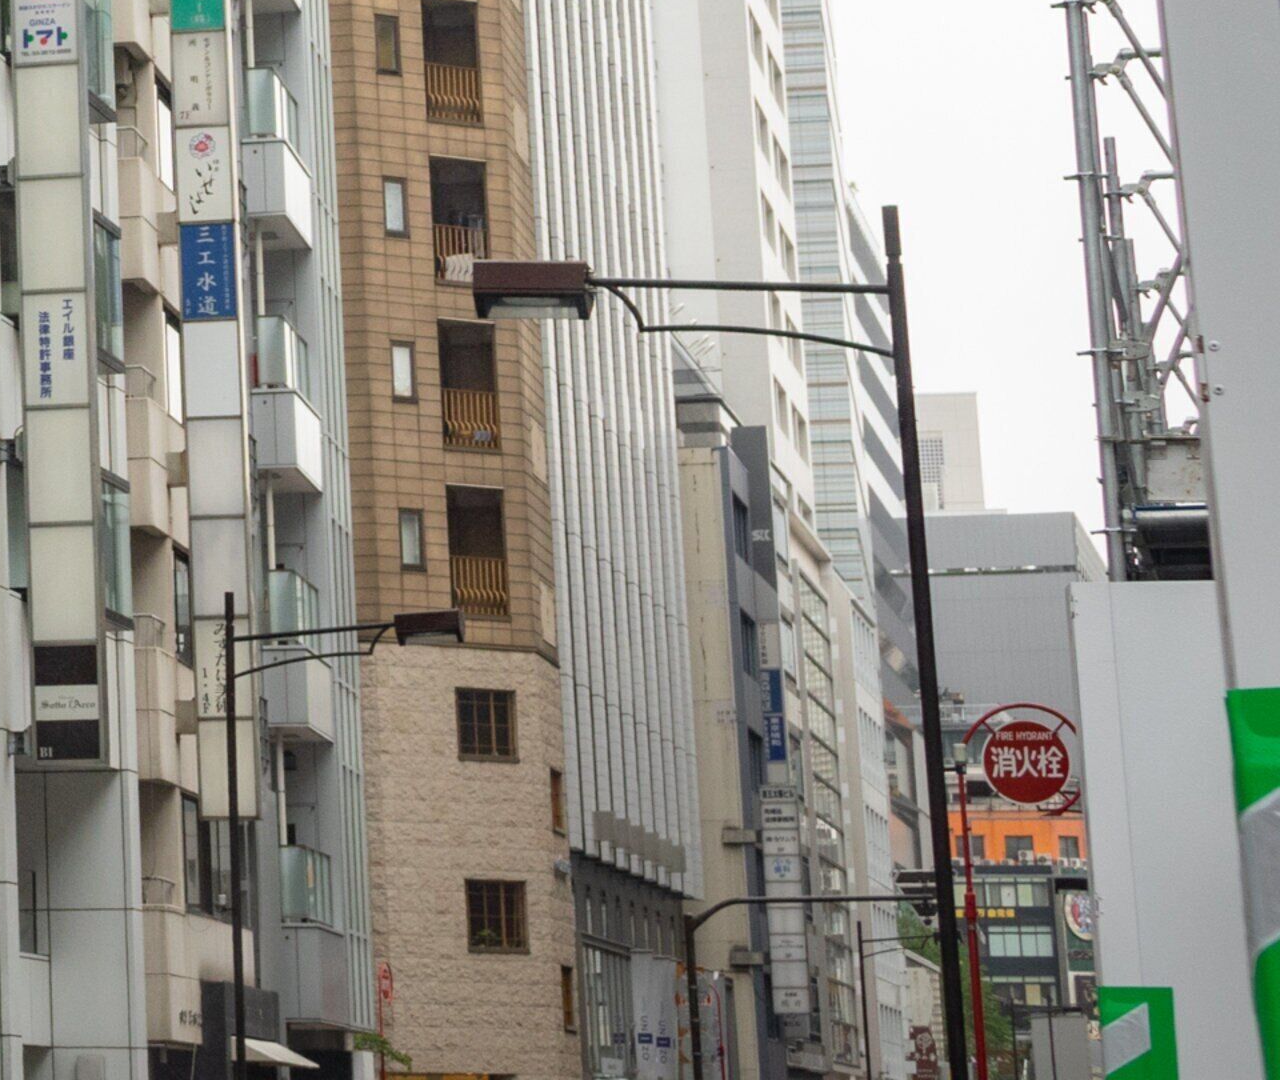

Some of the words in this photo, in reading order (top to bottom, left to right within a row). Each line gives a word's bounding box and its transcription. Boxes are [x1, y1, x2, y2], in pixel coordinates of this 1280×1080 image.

[22, 26, 69, 49] トマト
[196, 225, 219, 316] 三工水道
[995, 731, 1014, 741] FIRE
[1015, 731, 1053, 741] HYDRANT
[990, 745, 1065, 778] 消火栓
